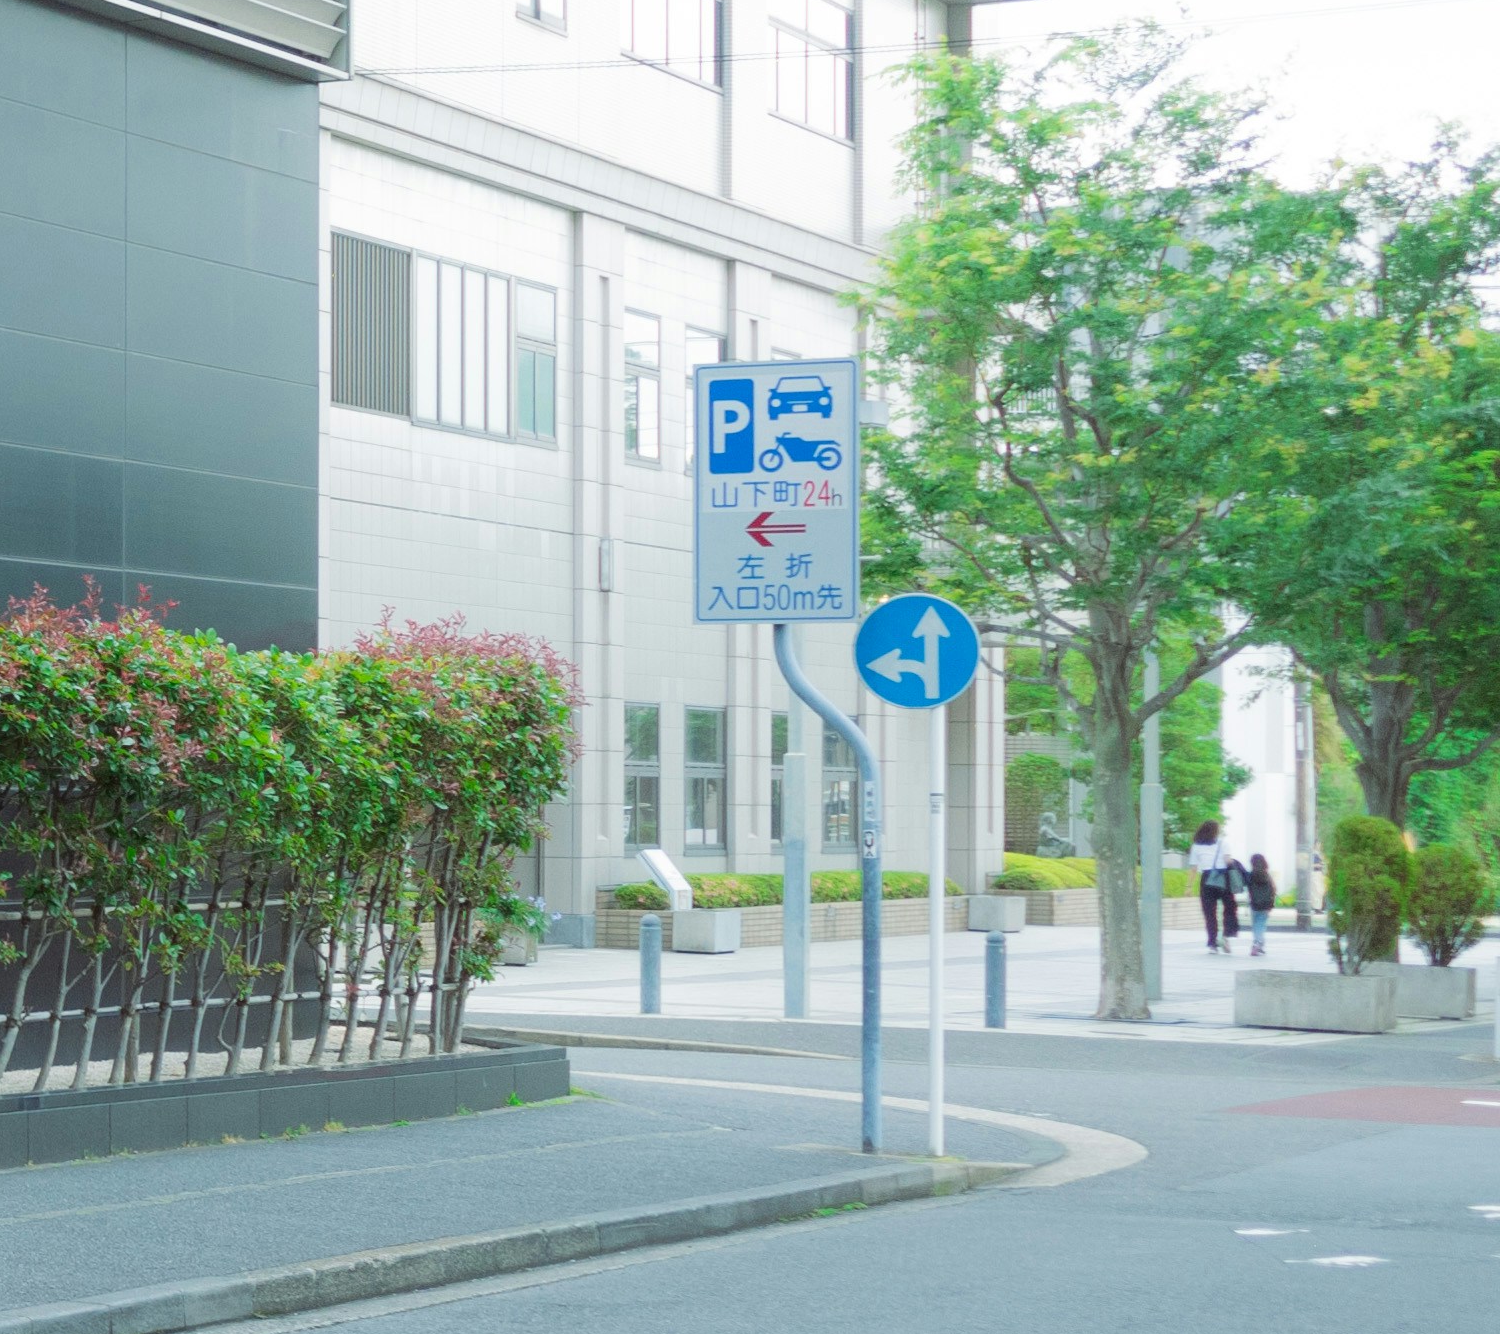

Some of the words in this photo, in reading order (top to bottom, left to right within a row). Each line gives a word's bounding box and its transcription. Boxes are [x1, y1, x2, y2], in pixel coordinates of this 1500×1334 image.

[713, 400, 749, 454] P
[708, 584, 843, 611] 入口50m先
